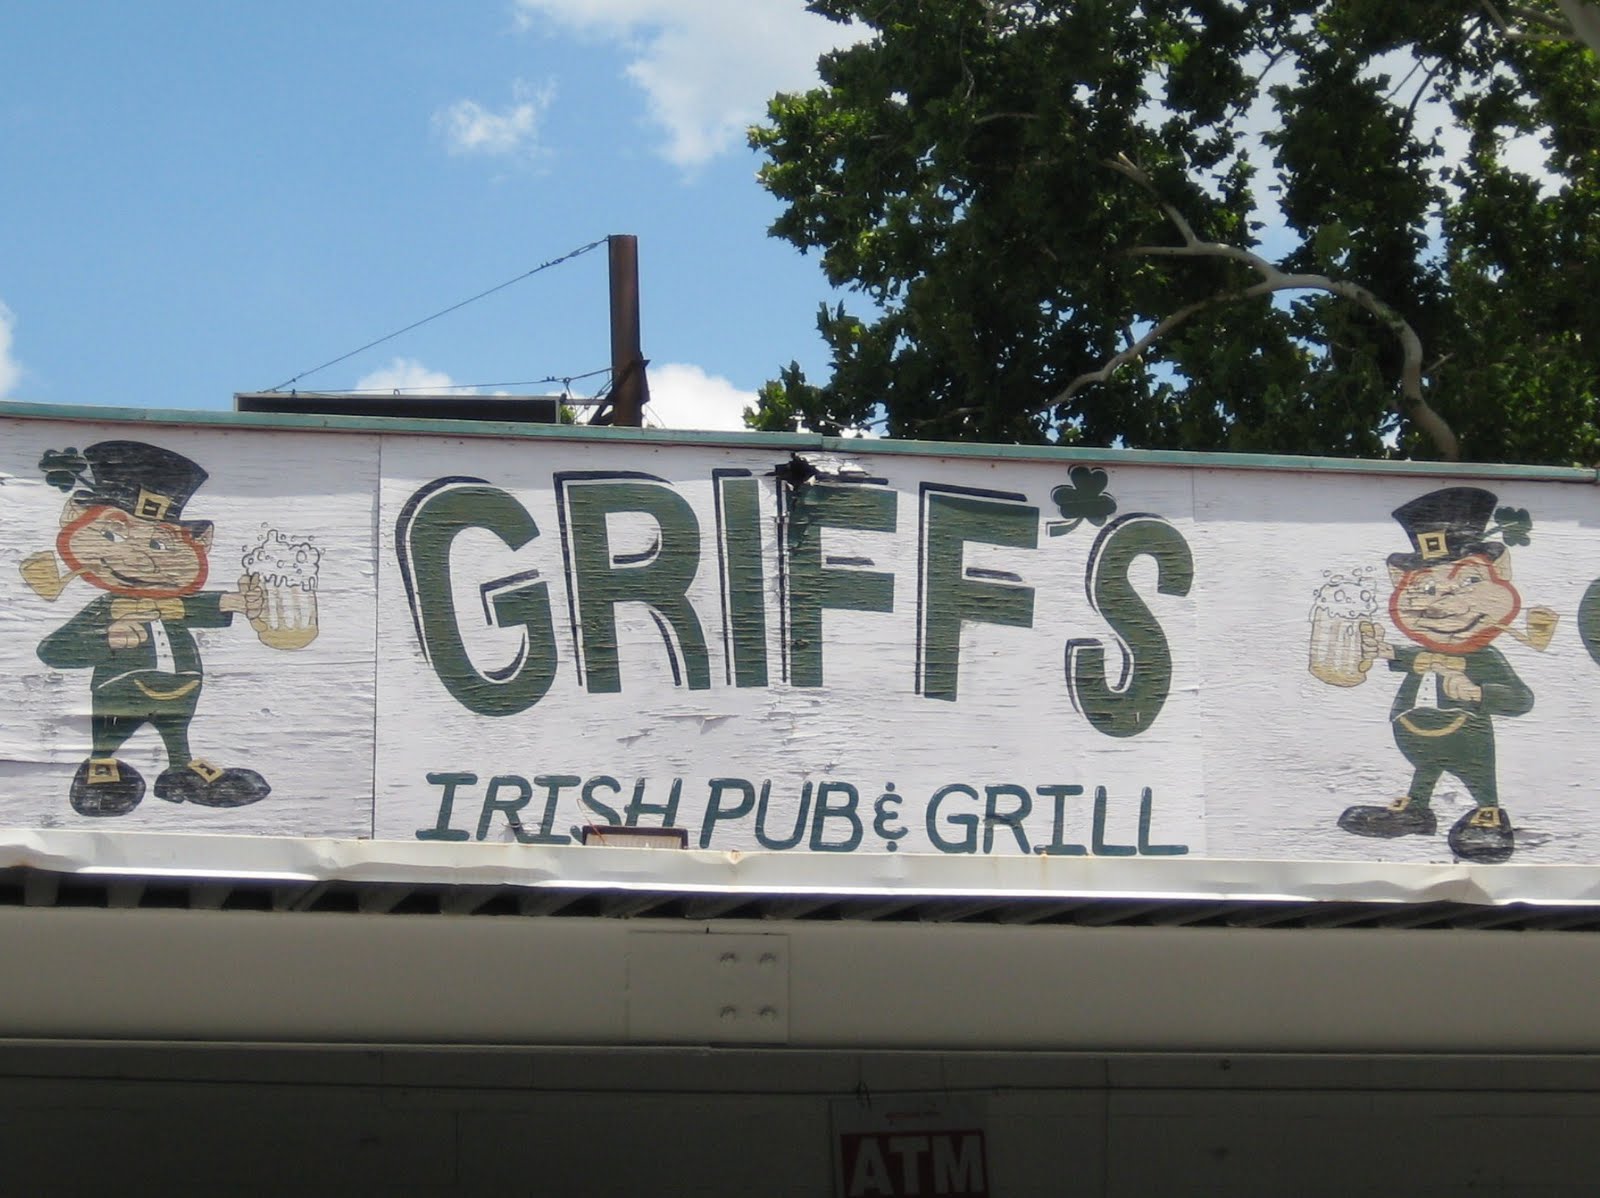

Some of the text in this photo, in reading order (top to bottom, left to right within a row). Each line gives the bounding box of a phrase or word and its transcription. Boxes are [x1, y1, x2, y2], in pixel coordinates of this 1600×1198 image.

[395, 466, 1194, 737] GRIFF'S
[415, 772, 1189, 856] IRISH PUB & GRILL
[848, 1135, 985, 1196] ATM
